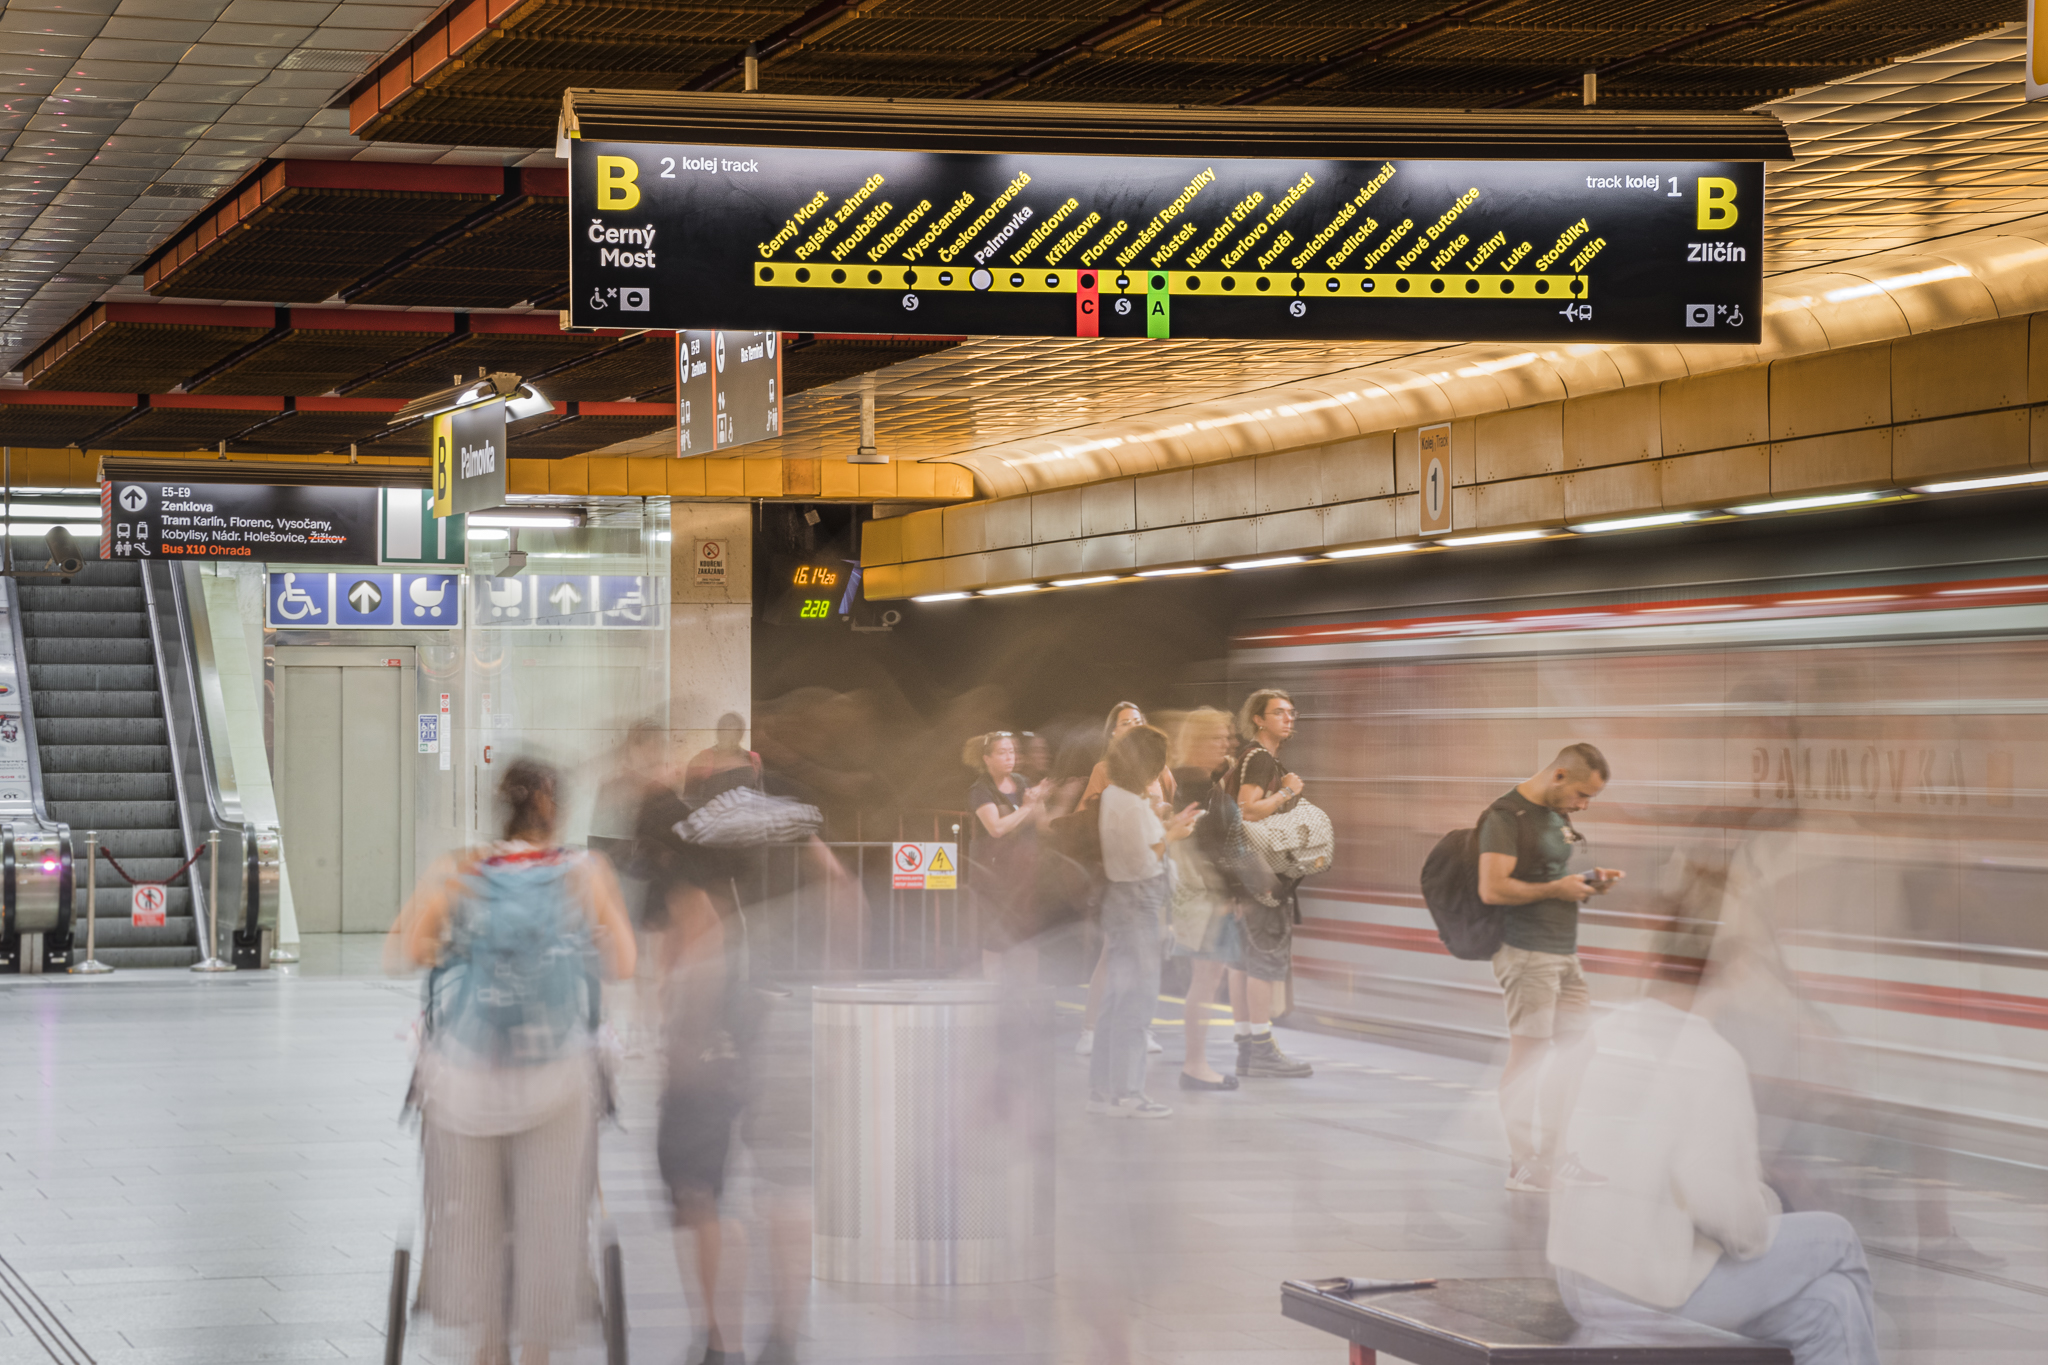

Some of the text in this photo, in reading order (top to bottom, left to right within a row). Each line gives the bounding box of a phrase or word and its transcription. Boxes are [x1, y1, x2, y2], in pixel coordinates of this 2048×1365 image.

[597, 155, 641, 211] B
[660, 156, 759, 178] 2 kolej track
[1586, 175, 1682, 197] track kolej 1
[758, 190, 829, 259] Černý Most
[795, 173, 885, 261] Rajská zahrada
[902, 190, 975, 262] Vysočanská
[937, 170, 1032, 263] Českomoravská
[1115, 166, 1216, 268] Náměstí Republiky
[1220, 171, 1316, 269] Karlovo náměstí
[1291, 161, 1397, 270] Smíchovské nádraží
[1697, 177, 1738, 230] B
[588, 219, 656, 249] Černý
[831, 201, 893, 262] Hloubětín
[866, 199, 932, 263] Kolbenova
[973, 206, 1034, 265] Palmovka
[1009, 197, 1079, 266] Invalidovna
[1045, 211, 1101, 267] Křižíkova
[1080, 220, 1128, 267] Florenc
[1150, 222, 1198, 268] Můstek
[1185, 191, 1264, 269] Národní třída
[1256, 229, 1295, 270] Anděl
[1325, 216, 1379, 271] Radlická
[1363, 218, 1414, 271] Jinonice
[1395, 186, 1480, 271] Nové Butovice
[1465, 230, 1507, 272] Lužiny
[1535, 217, 1590, 273] Stodůlky
[1687, 241, 1746, 262] Zličín
[600, 248, 656, 268] Most
[1430, 233, 1470, 272] Hůrka
[1500, 240, 1533, 272] Luka
[1569, 237, 1607, 273] Zličín
[1081, 299, 1094, 315] C
[1152, 301, 1165, 316] A
[461, 439, 495, 479] Palmovka
[1421, 434, 1449, 452] Kolej Track
[438, 436, 446, 501] B
[1431, 467, 1437, 511] 1
[161, 501, 214, 513] Zenklova
[162, 487, 191, 498] E5-E9
[161, 529, 209, 542] Kobylisy,
[212, 530, 241, 542] Nádr.
[244, 531, 307, 545] Holešovice,
[162, 515, 332, 532] Tram Karlín, Florenc, Vysočany,
[161, 544, 251, 556] Bus X10 Ohrada
[1752, 746, 1968, 806] PALMOVKA
